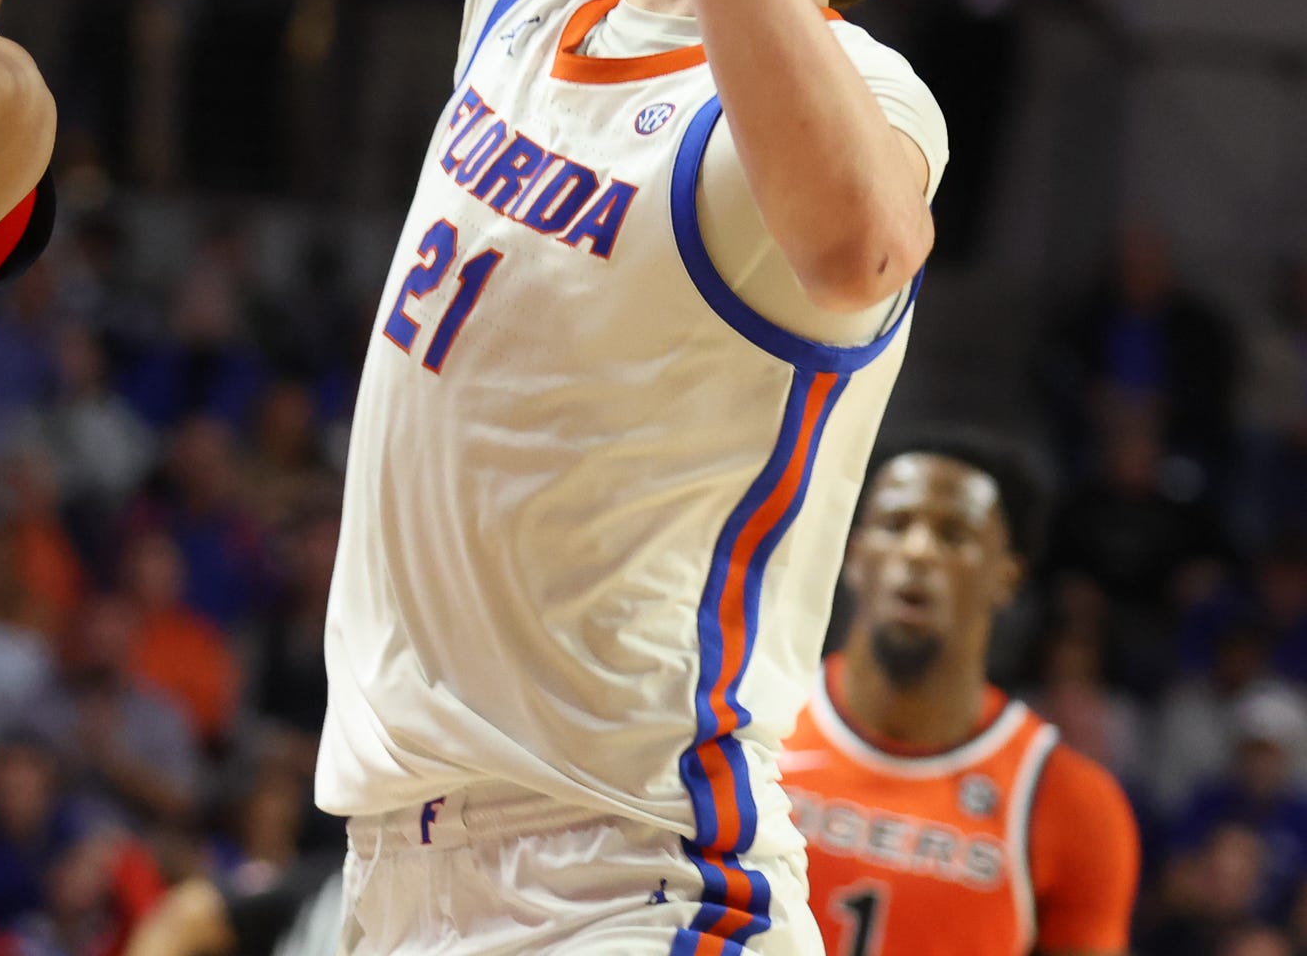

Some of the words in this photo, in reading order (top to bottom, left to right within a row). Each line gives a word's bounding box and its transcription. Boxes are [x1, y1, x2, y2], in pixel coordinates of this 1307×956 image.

[438, 84, 639, 260] FLORIDA
[383, 218, 504, 375] 21
[786, 786, 1006, 892] IGERS
[828, 877, 891, 956] 1
